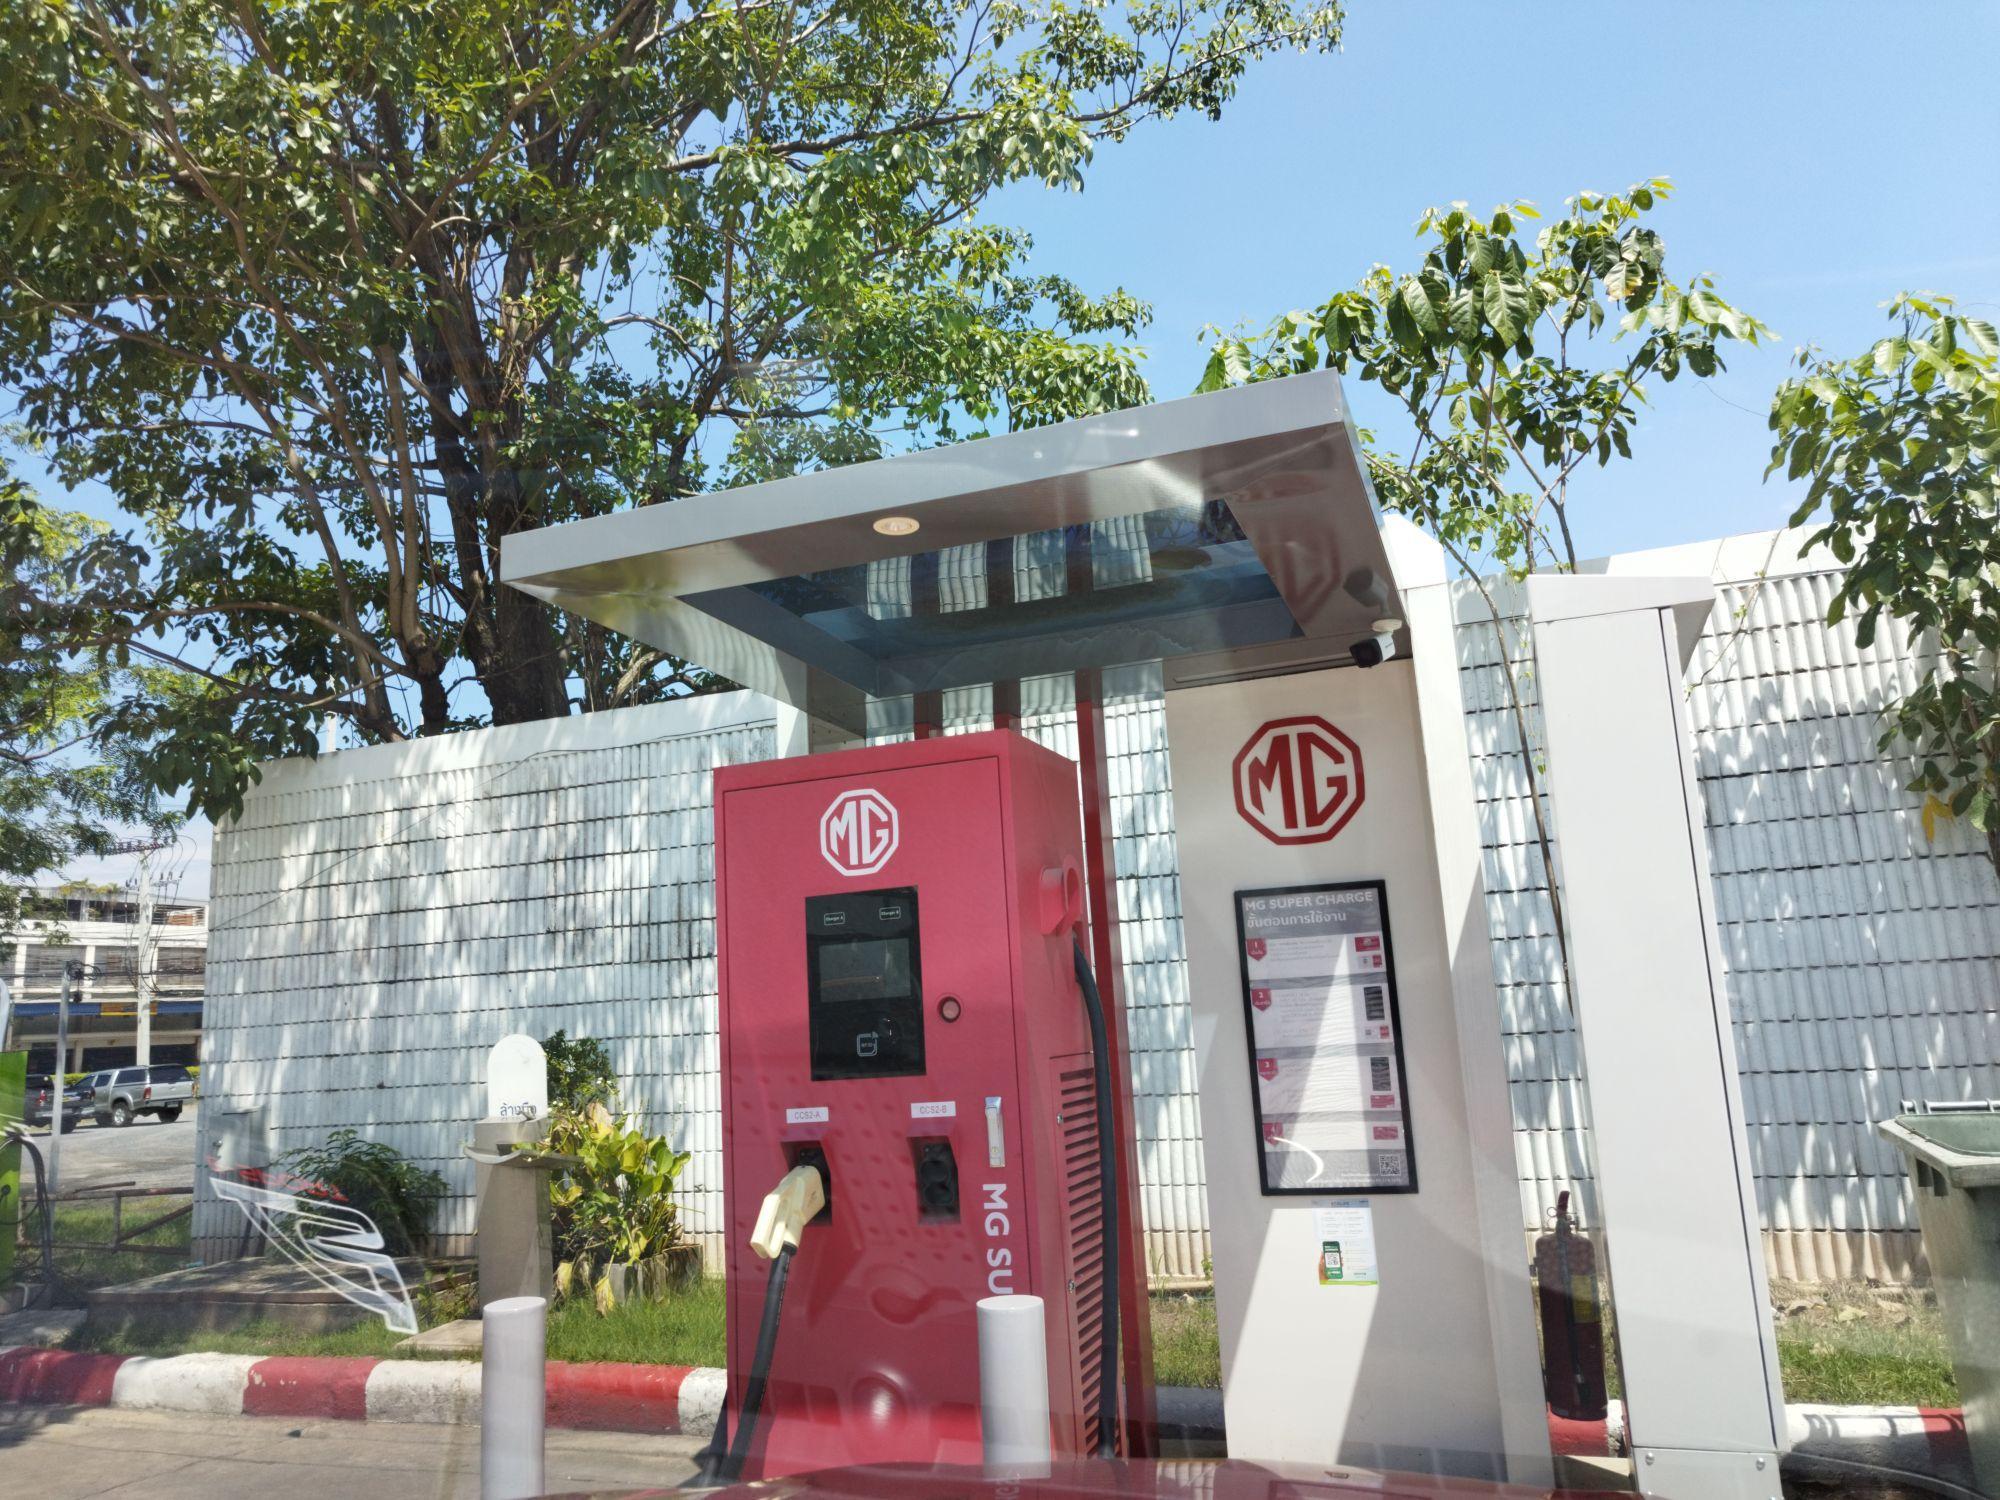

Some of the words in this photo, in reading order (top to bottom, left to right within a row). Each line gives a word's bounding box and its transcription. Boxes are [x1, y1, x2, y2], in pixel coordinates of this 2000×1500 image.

[1248, 731, 1348, 829] MG
[829, 799, 889, 866] MG
[1245, 900, 1266, 911] MG
[1269, 897, 1312, 909] SUPER
[1315, 891, 1373, 904] CHARGE
[794, 1111, 821, 1120] CCS2-A
[920, 1105, 947, 1114] CCS2-B
[983, 1184, 1010, 1236] MG
[987, 1248, 1014, 1295] SU
